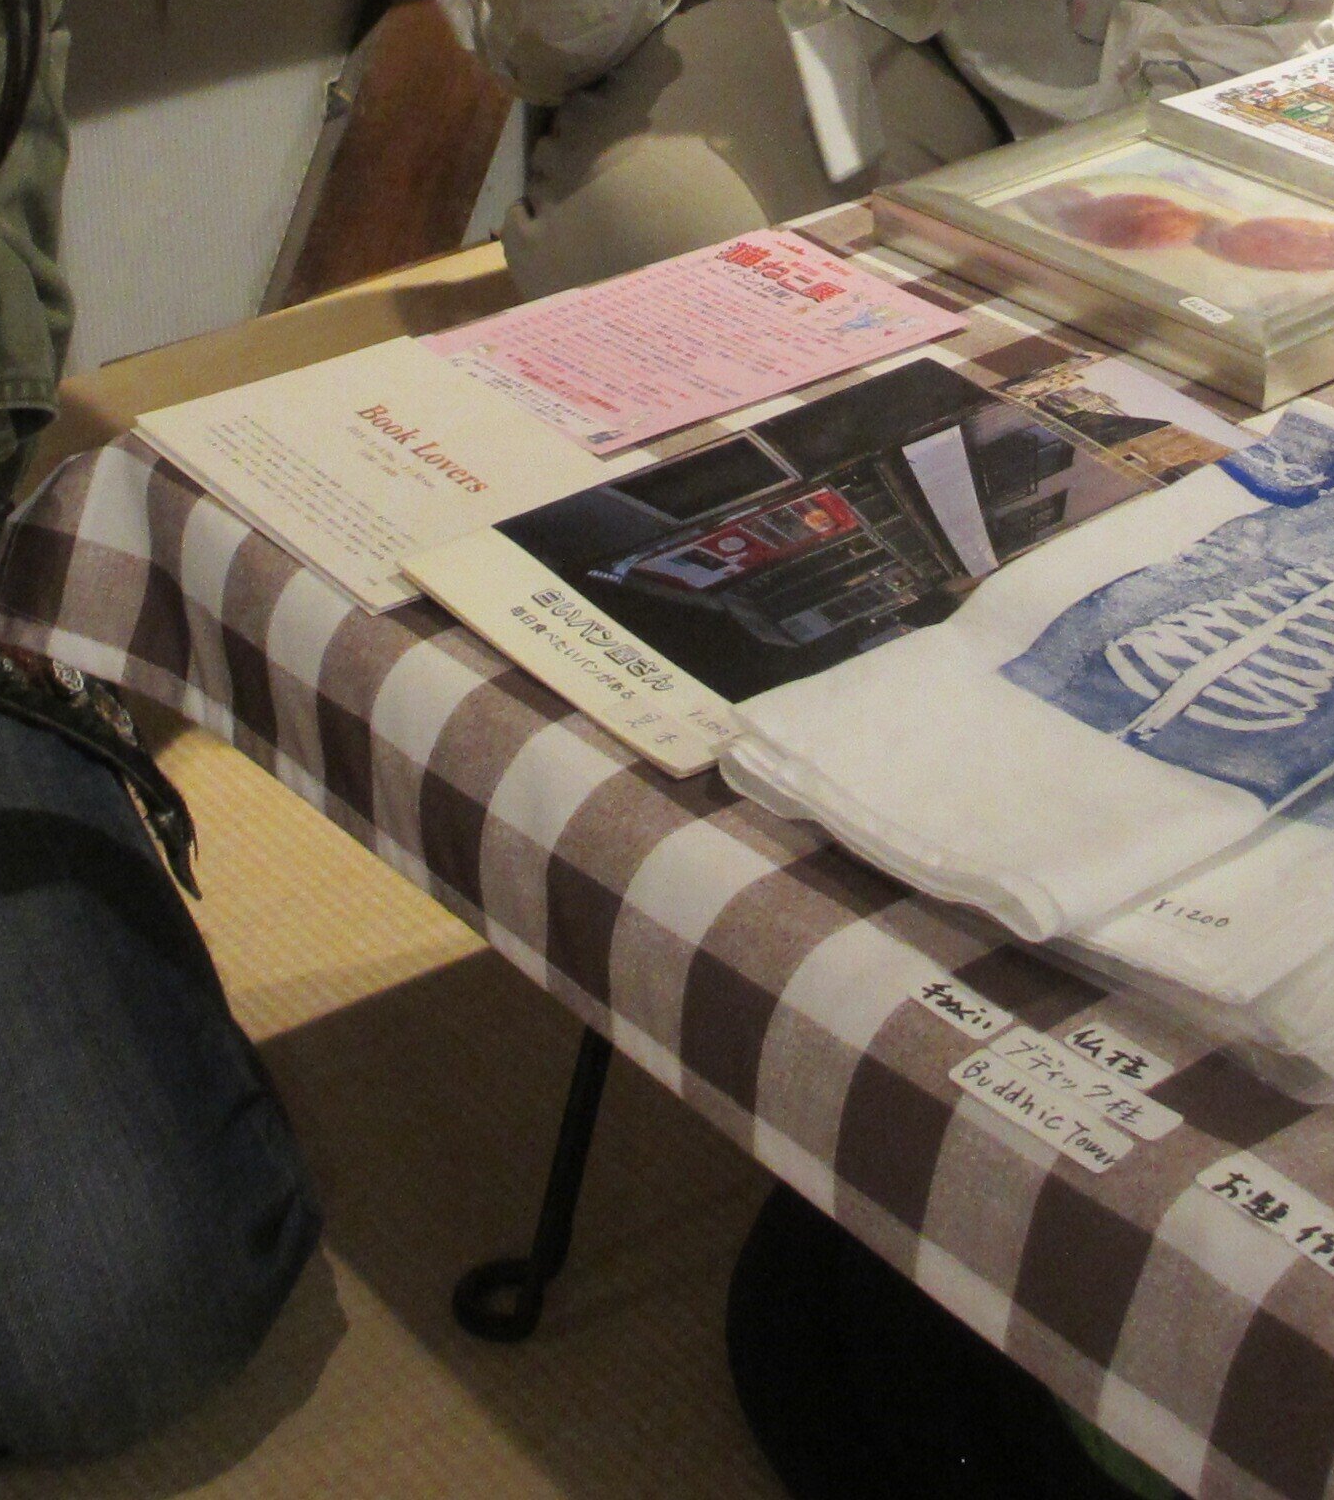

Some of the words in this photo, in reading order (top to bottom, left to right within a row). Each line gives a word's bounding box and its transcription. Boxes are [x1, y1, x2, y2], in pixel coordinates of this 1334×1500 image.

[356, 404, 421, 445] Book
[409, 441, 489, 493] Lovers
[510, 605, 637, 701] 毎日食べたいパンがある
[530, 587, 676, 692] 白いパン屋さん
[961, 1060, 1065, 1130] Buddhic
[1063, 1120, 1117, 1166] Tower
